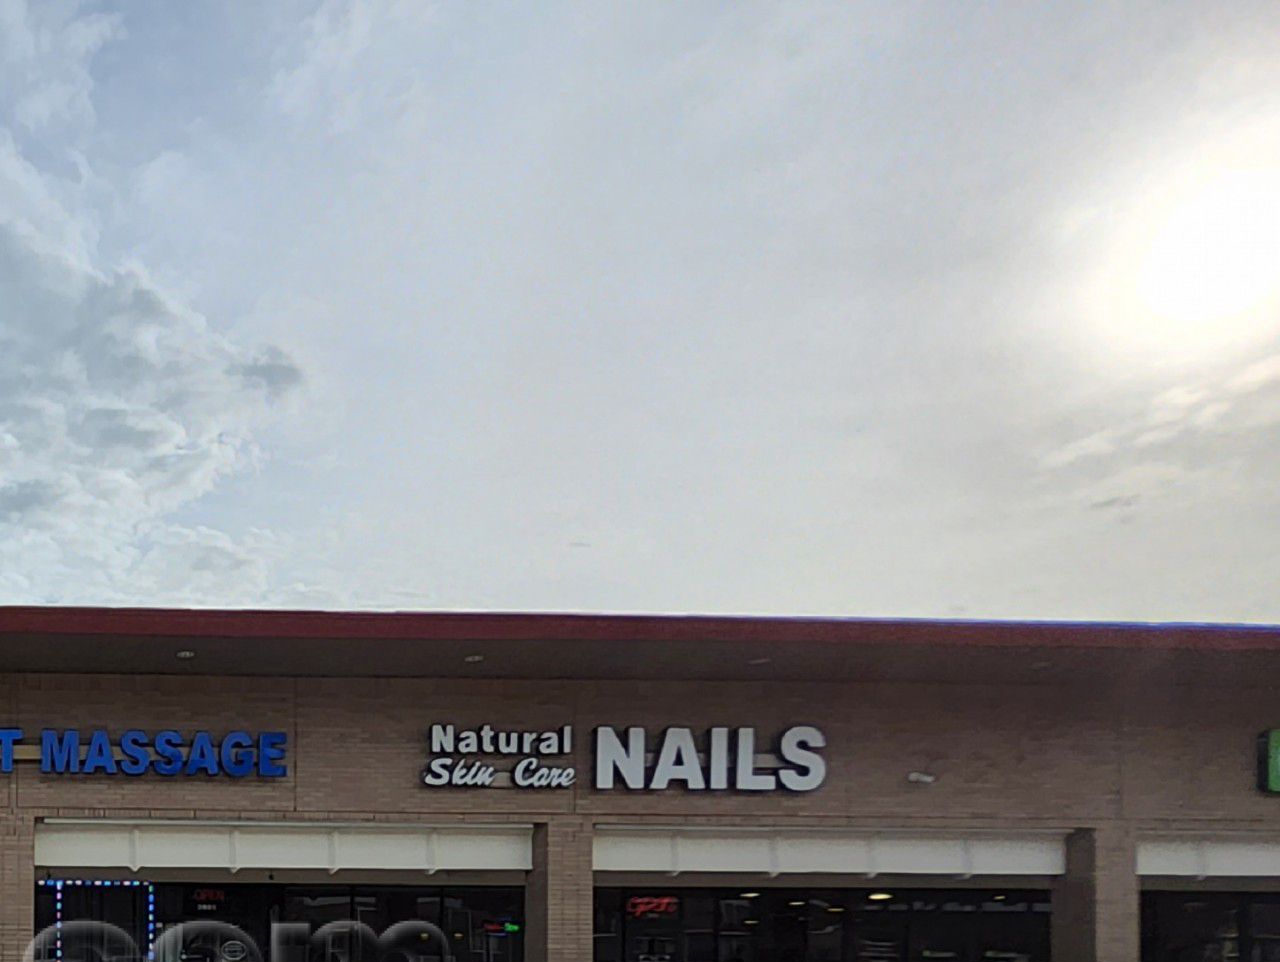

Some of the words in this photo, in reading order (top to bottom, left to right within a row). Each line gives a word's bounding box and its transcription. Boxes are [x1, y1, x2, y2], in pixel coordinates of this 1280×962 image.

[40, 729, 288, 777] MASSAGE
[430, 724, 572, 754] Natural
[595, 725, 827, 791] NAILS
[424, 757, 496, 787] Skin
[514, 757, 576, 789] Care
